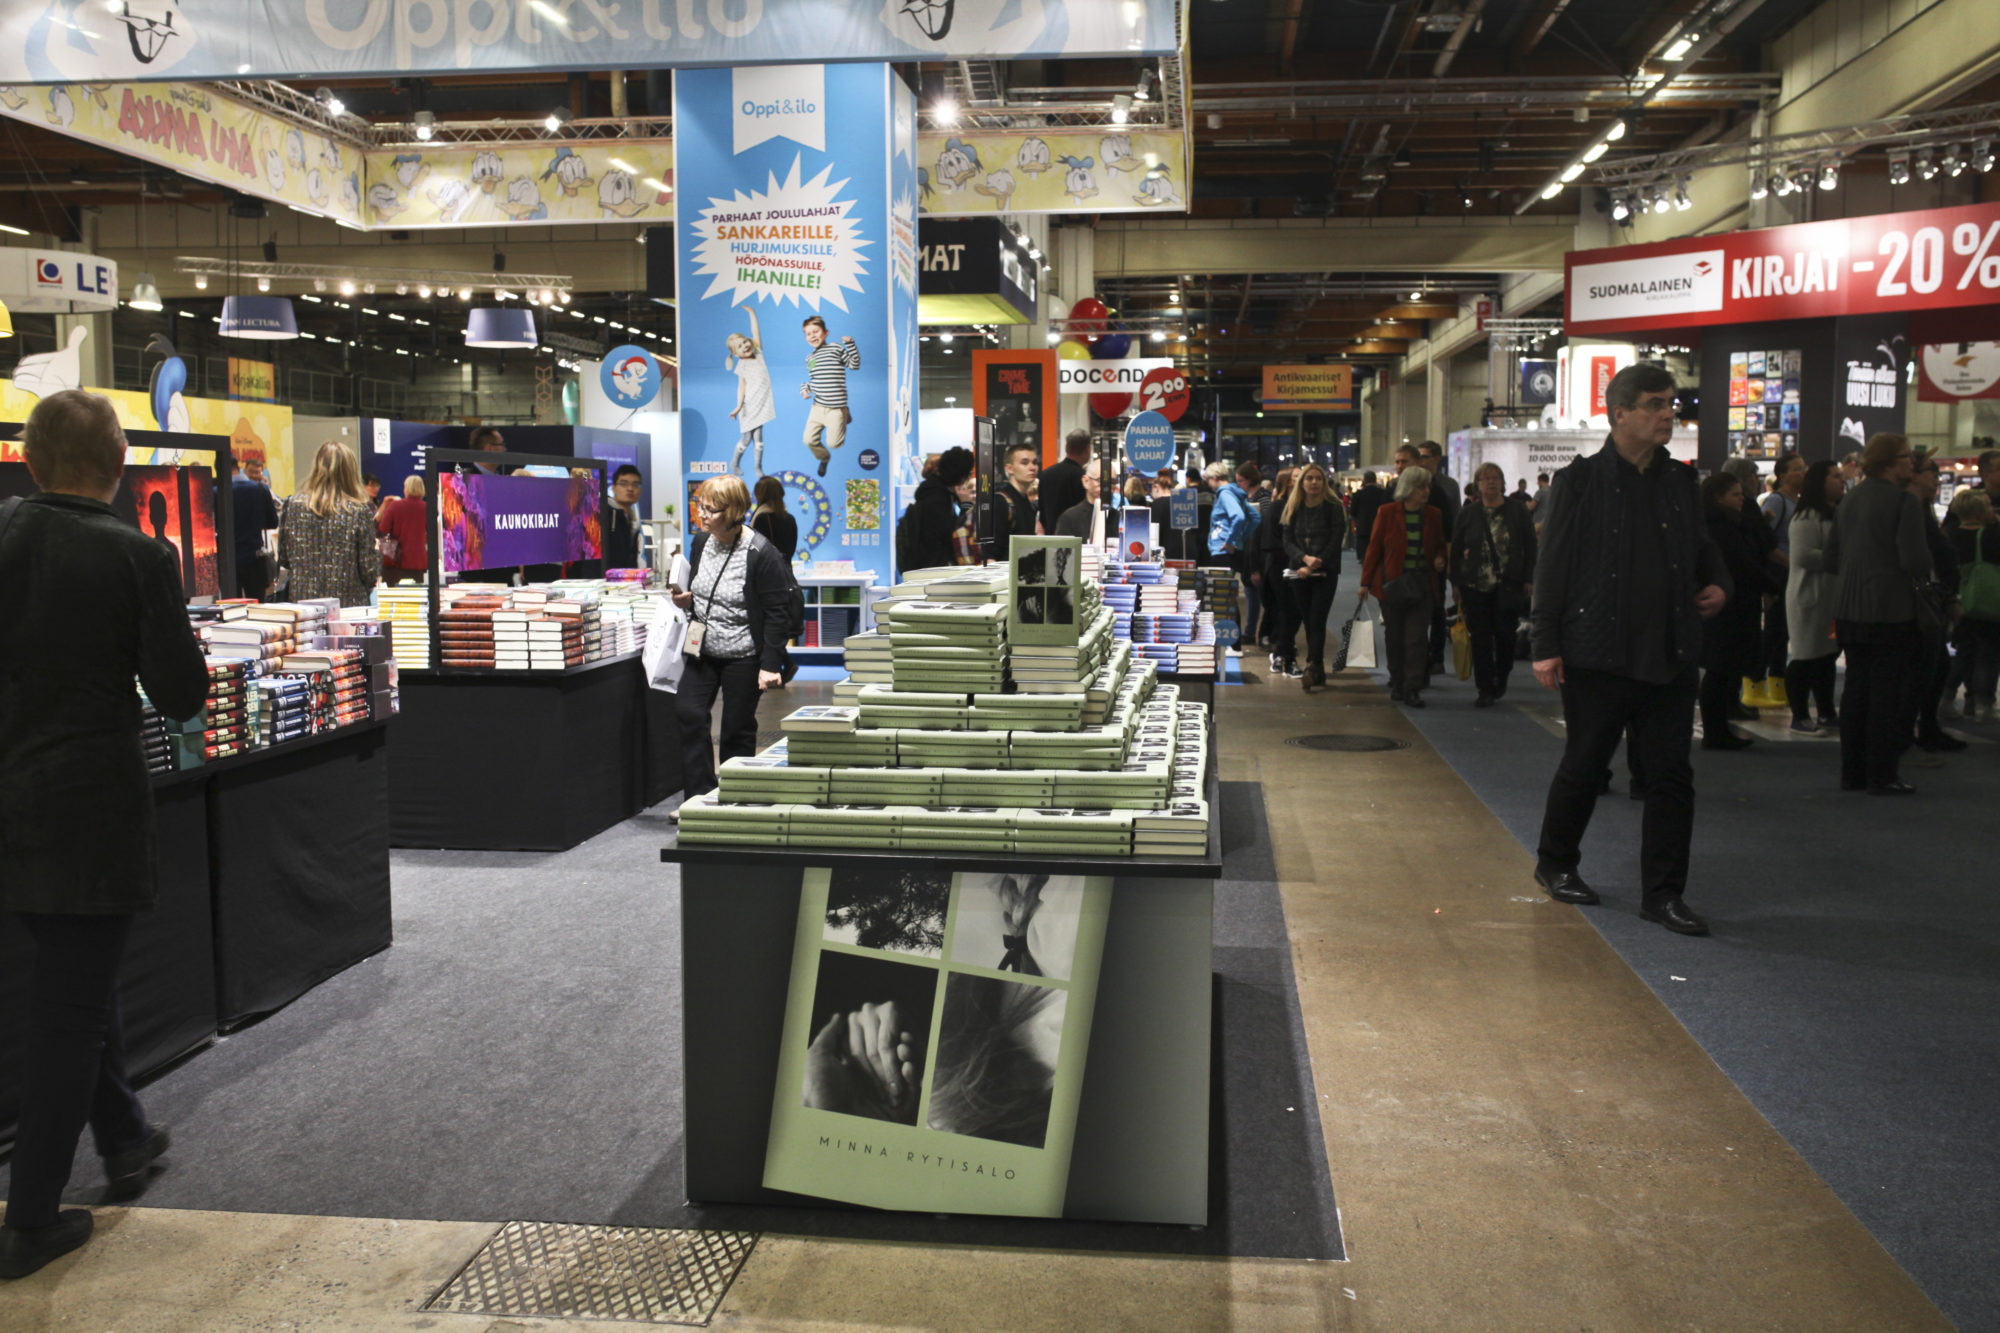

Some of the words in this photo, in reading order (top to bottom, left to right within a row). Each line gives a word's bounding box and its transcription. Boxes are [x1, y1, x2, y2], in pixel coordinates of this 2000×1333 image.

[712, 211, 762, 224] PARHAAT
[766, 206, 841, 221] JOULULAHJAT
[717, 224, 839, 241] SANKAREILLE,
[730, 242, 837, 257] HURJIMUKSILLE,
[735, 254, 826, 272] HÖPÖNASSUILLE,
[737, 267, 822, 289] IHANILLE!
[1731, 252, 1840, 299] KIRJAT
[1589, 278, 1693, 299] SUOMALAINEN
[1273, 372, 1342, 382] Antikvaariset
[1277, 384, 1337, 396] Kirjamessut
[1846, 381, 1870, 406] UUSI
[1870, 383, 1896, 408] LUKU
[1130, 425, 1170, 435] PARHAAT
[1134, 438, 1165, 448] JOULU-
[1135, 451, 1166, 460] LAHJAT
[1528, 454, 1539, 463] 10
[1541, 455, 1557, 463] 000
[1173, 503, 1194, 511] PELIT
[494, 513, 560, 530] KAUNOKIRJAT
[819, 1135, 888, 1157] MINNA
[906, 1151, 1016, 1180] RYTISALO
